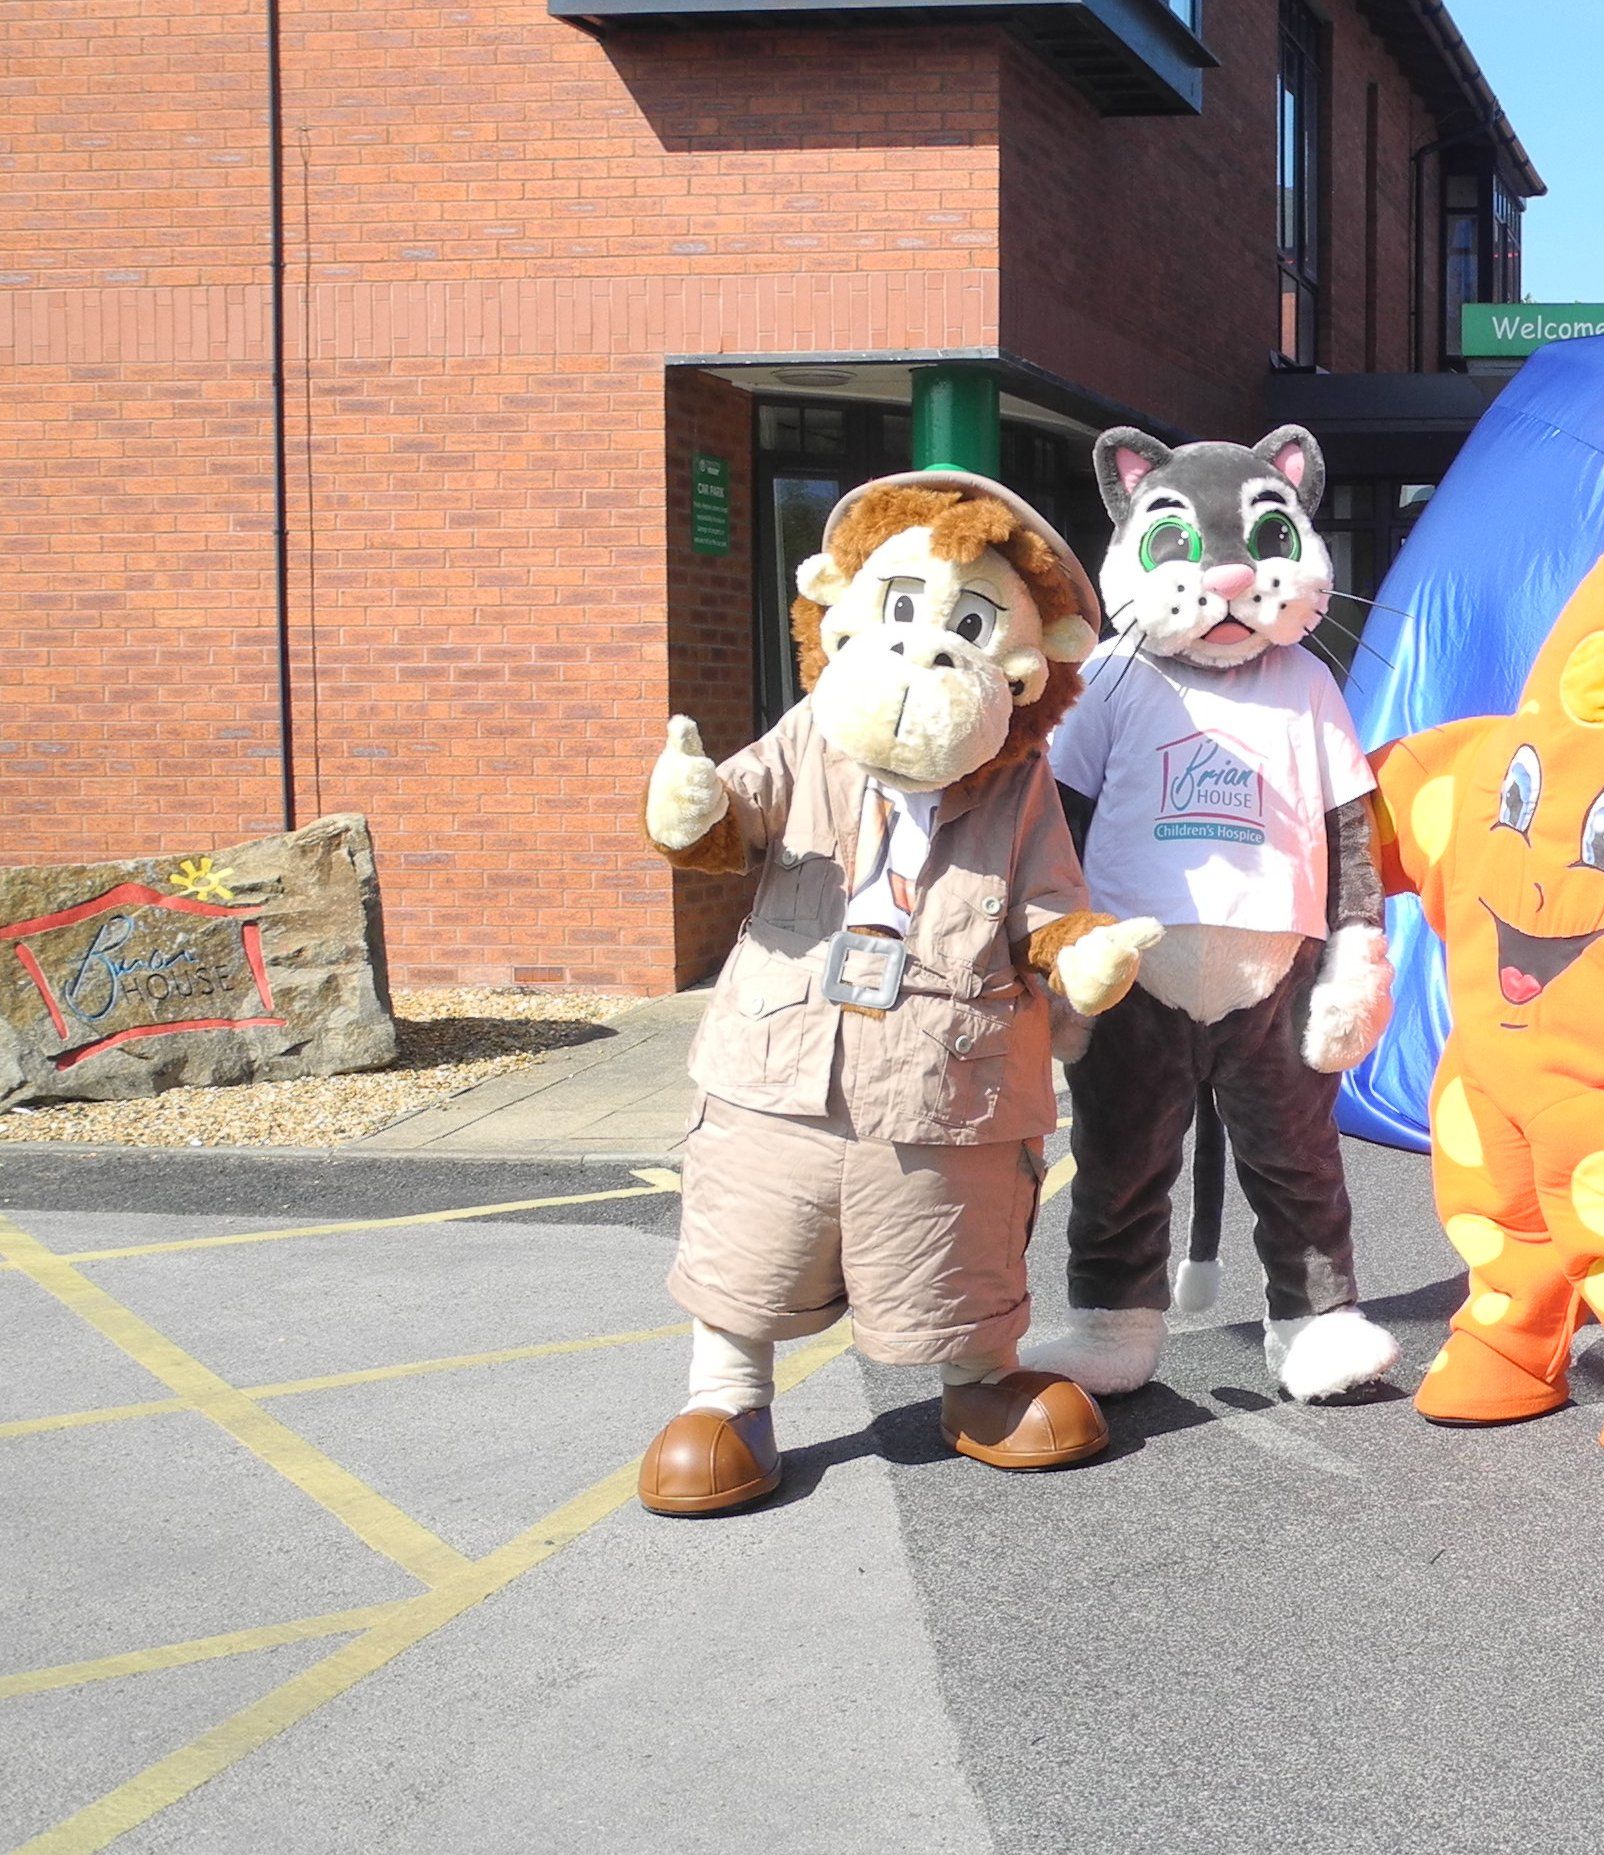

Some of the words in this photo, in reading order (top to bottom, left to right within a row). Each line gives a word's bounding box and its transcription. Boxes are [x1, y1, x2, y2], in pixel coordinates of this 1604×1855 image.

[1170, 738, 1255, 811] Brian
[1197, 788, 1253, 809] HOUSE
[1156, 824, 1215, 838] Children's
[1217, 825, 1263, 844] Hospice
[64, 914, 201, 1021] Brian
[120, 964, 235, 1005] HOUSE
